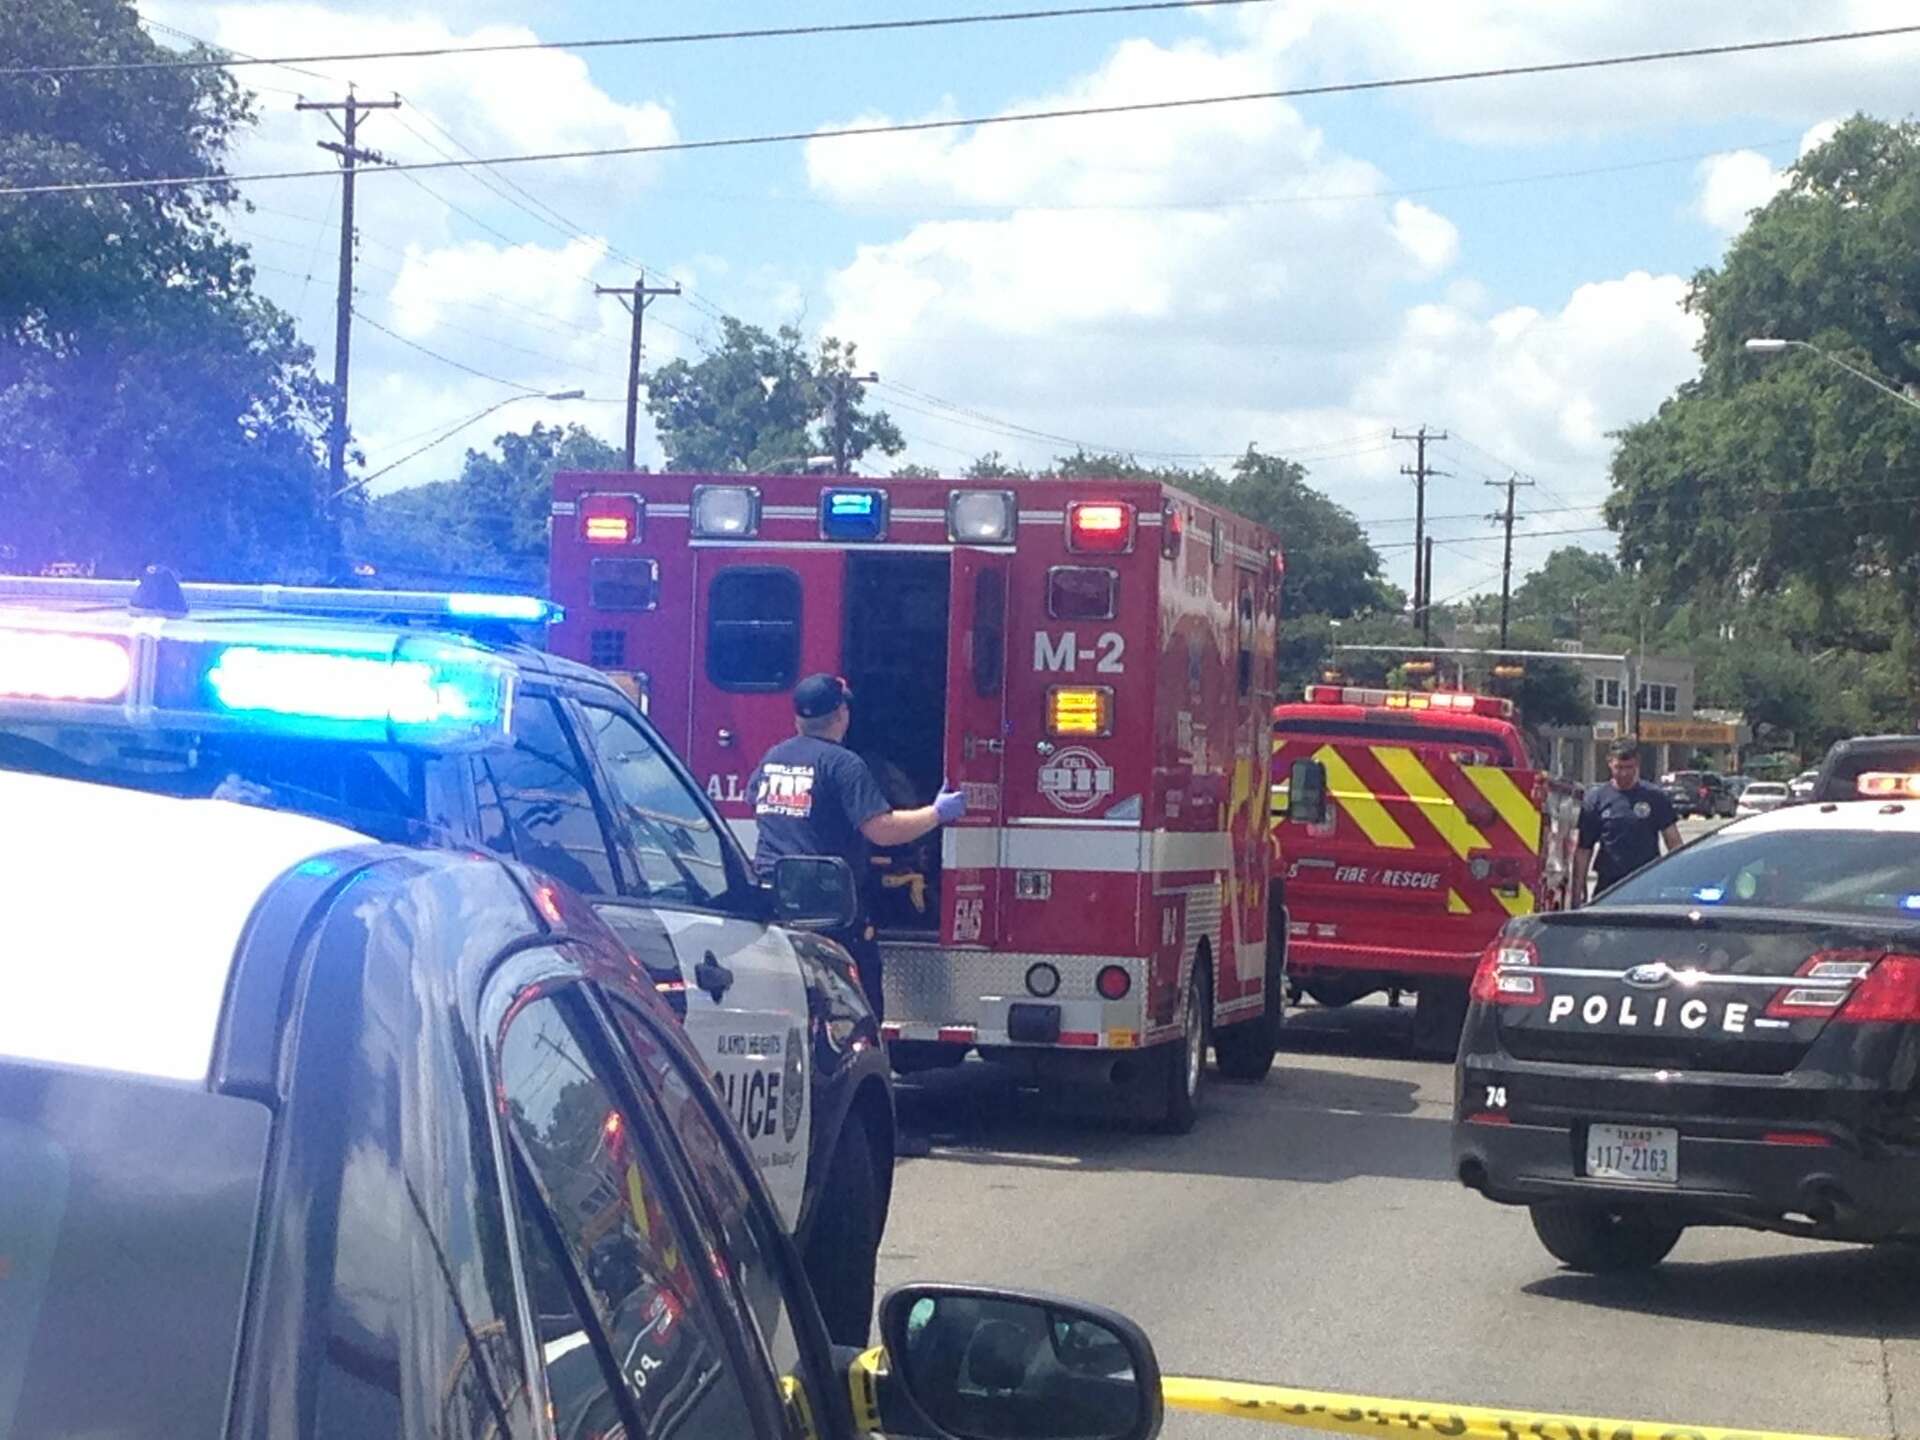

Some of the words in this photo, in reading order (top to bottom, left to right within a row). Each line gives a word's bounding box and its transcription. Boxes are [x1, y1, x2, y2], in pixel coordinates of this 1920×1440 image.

[1034, 631, 1125, 673] M-2
[1042, 768, 1111, 791] 911
[1335, 867, 1368, 883] FIRE
[1382, 871, 1440, 889] RESCUE
[1549, 995, 1749, 1033] POLICE
